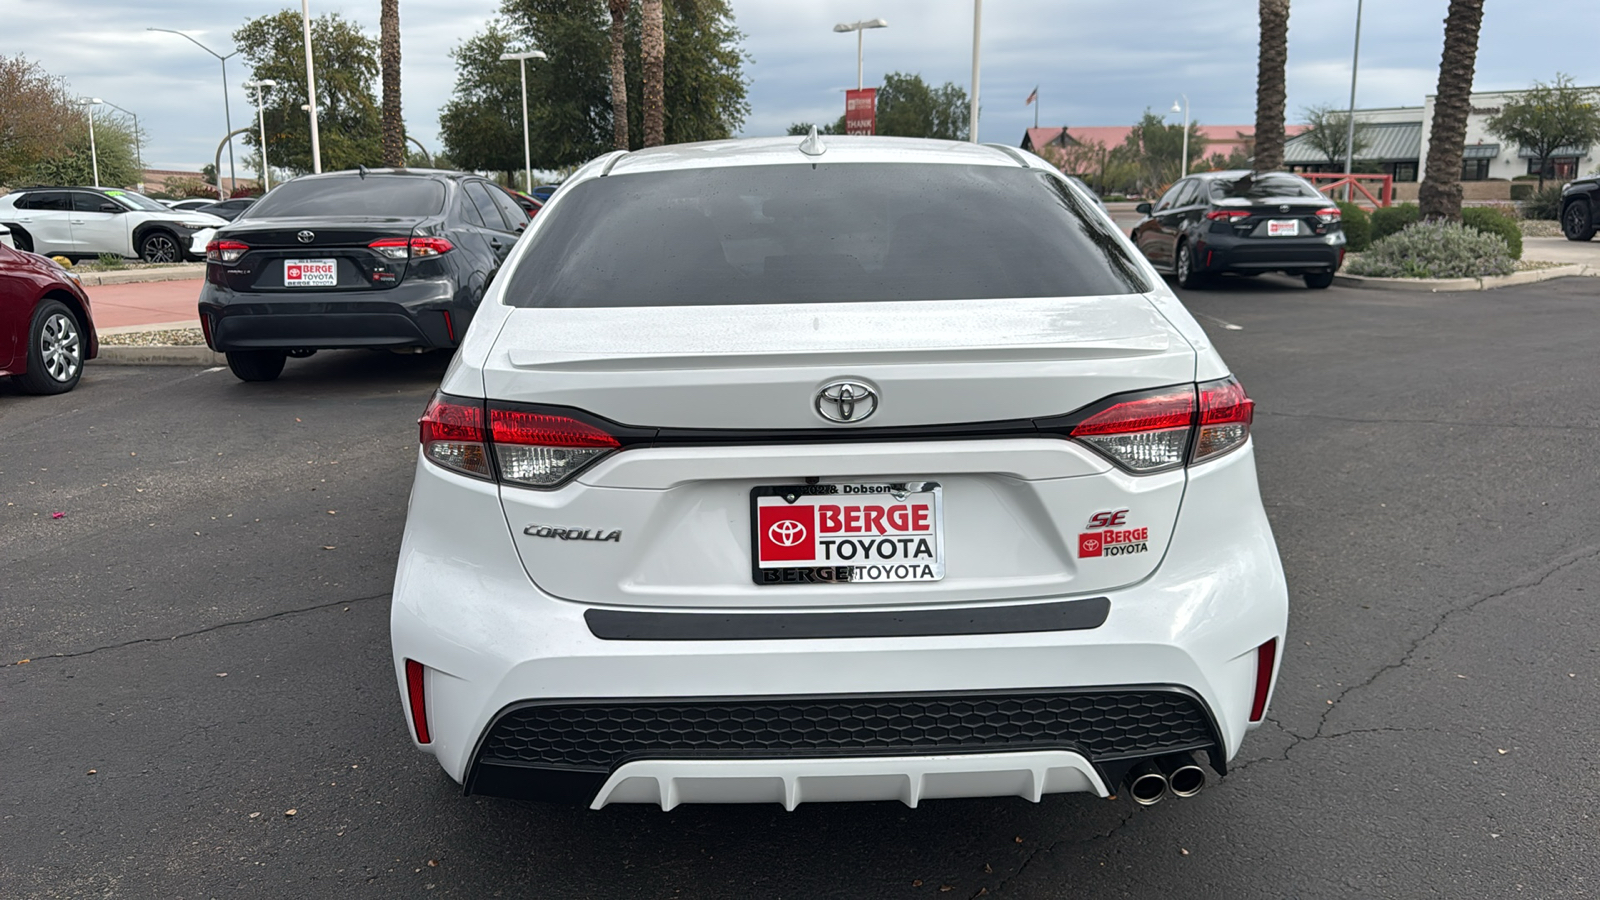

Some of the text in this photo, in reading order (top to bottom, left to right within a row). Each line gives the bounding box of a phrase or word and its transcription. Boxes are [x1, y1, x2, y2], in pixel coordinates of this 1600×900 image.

[847, 120, 872, 128] THANK
[303, 265, 333, 273] BERGE
[829, 484, 839, 494] &
[843, 484, 891, 494] Dobson
[818, 504, 930, 535] BERGE
[1086, 509, 1129, 530] SE
[523, 524, 622, 542] COROLLA
[1103, 527, 1148, 544] BERGE
[819, 538, 933, 560] TOYOTA
[1103, 543, 1148, 557] TOYOTA
[763, 564, 934, 583] BERGE TOYOTA
